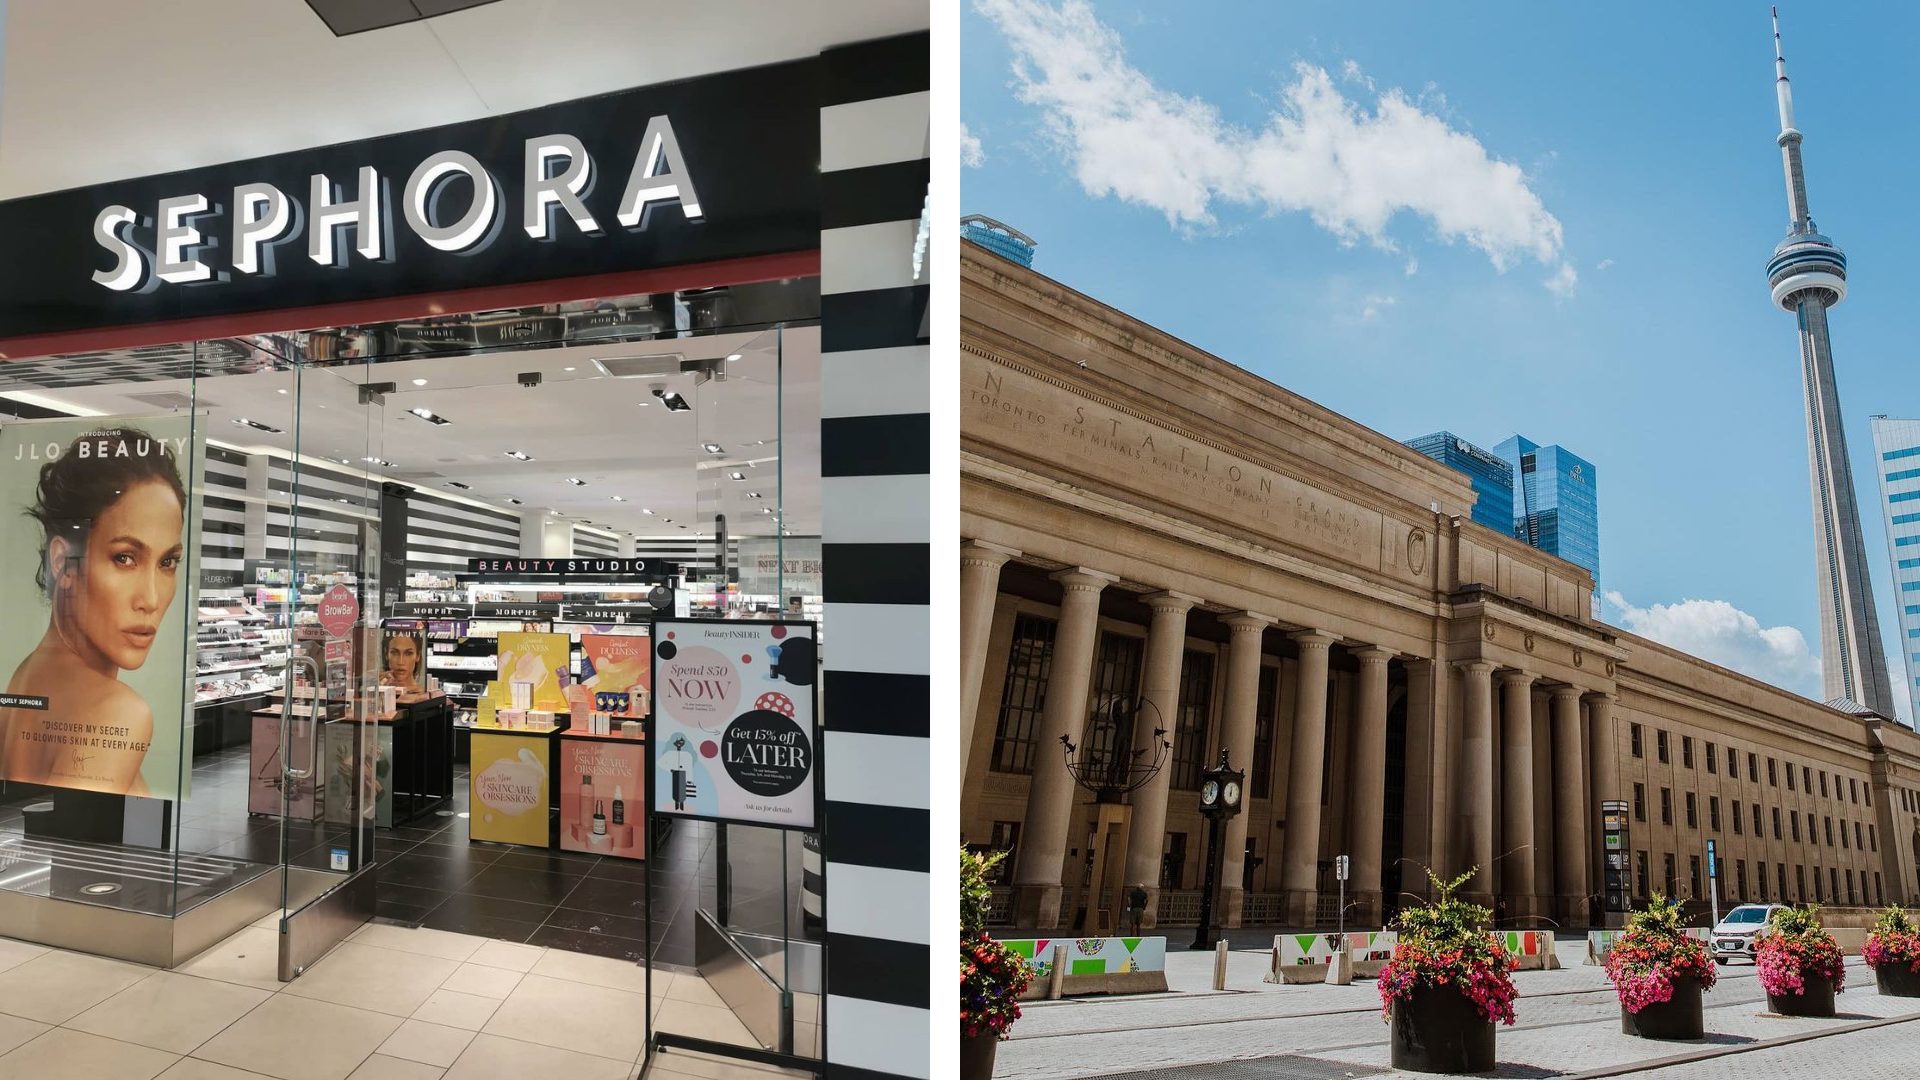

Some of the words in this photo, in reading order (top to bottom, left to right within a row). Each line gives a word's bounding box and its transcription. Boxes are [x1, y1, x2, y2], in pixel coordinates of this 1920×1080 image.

[92, 114, 704, 293] SEPHORA
[15, 443, 60, 461] JLO
[78, 438, 188, 459] BEAUTY
[971, 390, 1046, 425] TORONTO
[1063, 423, 1141, 460] TERMINALS
[1152, 456, 1207, 481] RAILWAY
[1218, 480, 1270, 505] COMPANY
[1074, 406, 1272, 494] STATION
[479, 560, 555, 572] BEAUTY
[567, 561, 646, 572] STUDIO
[324, 604, 354, 616] BrowBar
[413, 607, 453, 615] MORPHE
[495, 608, 538, 616] MORPHE
[586, 610, 632, 619] MORPHE
[385, 630, 423, 638] BEAUTY
[671, 665, 704, 678] Spend
[706, 666, 728, 677] $50
[668, 679, 731, 700] NOW
[18, 698, 43, 706] SEPHORA
[42, 720, 83, 733] "DISCOVER
[86, 725, 97, 734] MY
[100, 727, 129, 737] SECRET
[731, 727, 751, 740] Get
[754, 728, 777, 742] 15%
[22, 732, 30, 741] TO
[33, 733, 67, 745] GLOWING
[69, 736, 88, 746] SKIN
[90, 739, 100, 748] AT
[102, 740, 127, 750] EVERY
[578, 755, 628, 768] SKINCARE
[726, 742, 806, 769] LATER
[574, 765, 633, 778] OBSESSIONS
[486, 783, 532, 795] SKINCARE
[482, 793, 537, 804] OBSESSIONS
[763, 805, 772, 813] for
[772, 805, 793, 813] details
